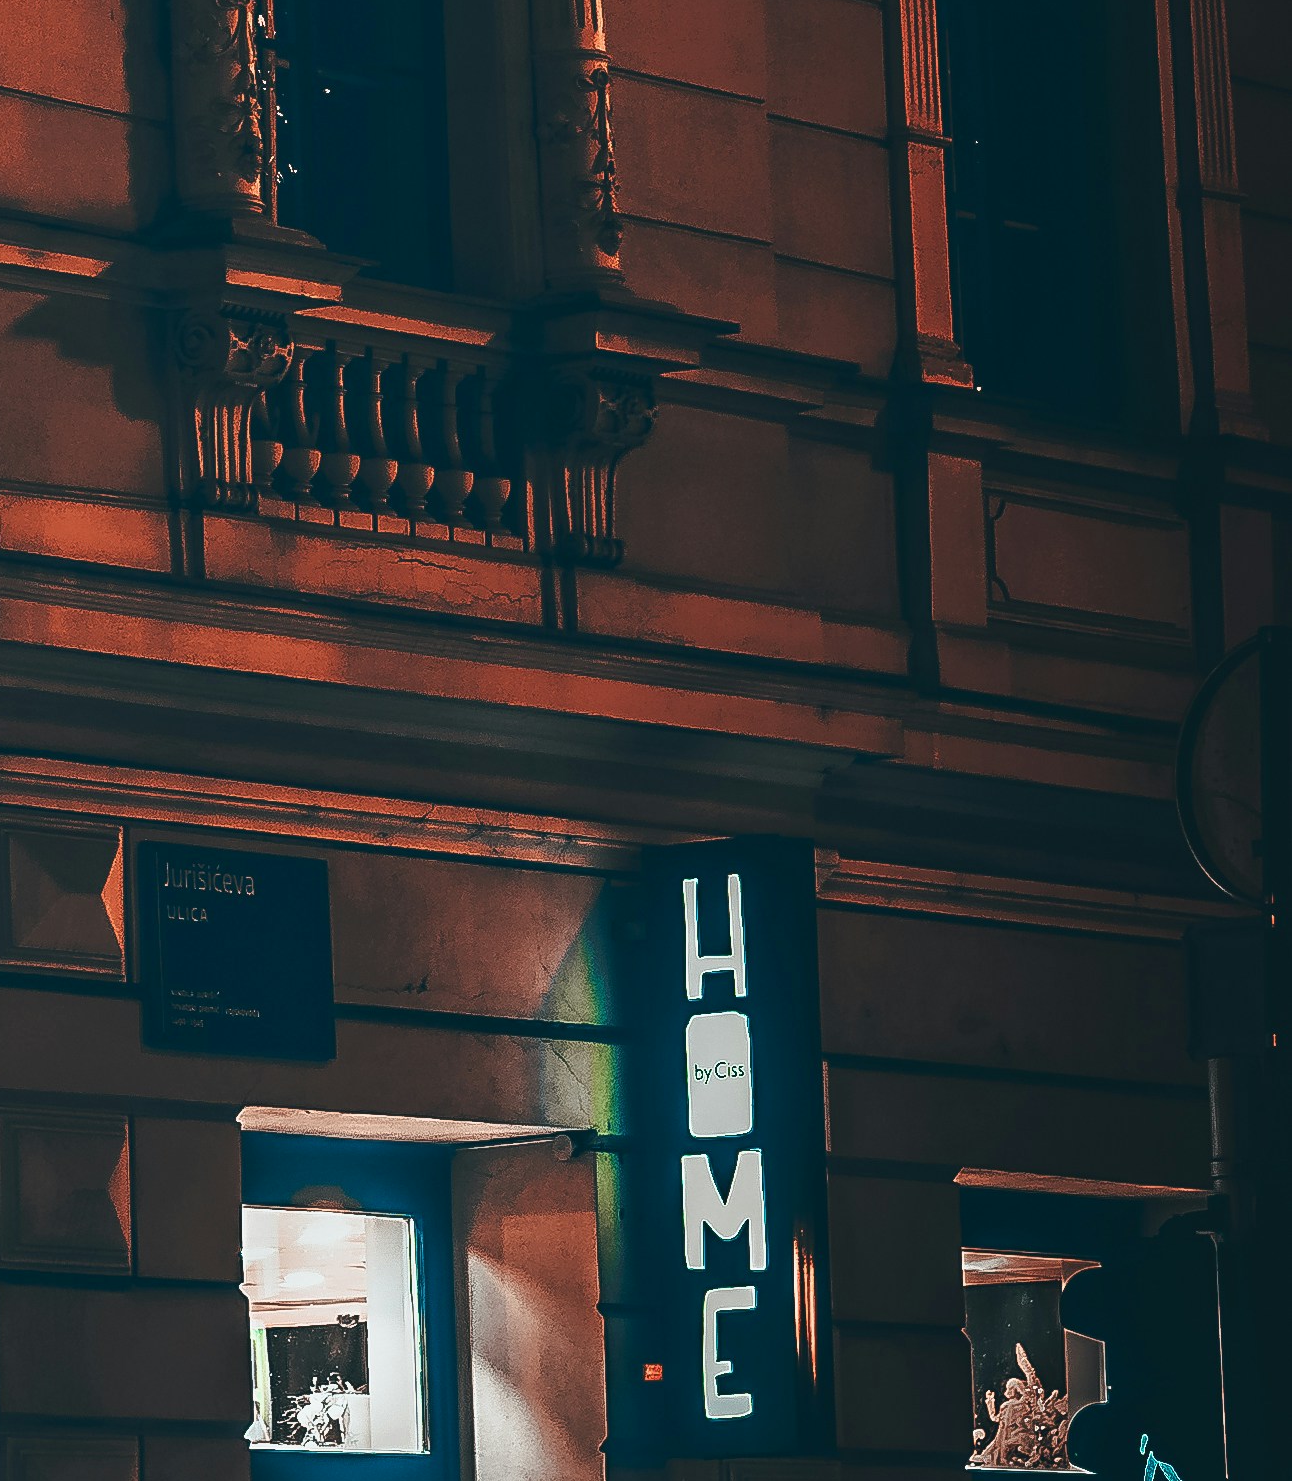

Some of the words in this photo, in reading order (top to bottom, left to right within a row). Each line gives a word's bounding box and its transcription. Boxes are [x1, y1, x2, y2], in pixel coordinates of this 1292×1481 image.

[163, 861, 255, 896] Jurišićeva
[166, 904, 208, 922] ULICA
[695, 1064, 713, 1084] by
[715, 1061, 745, 1078] Ciss
[680, 873, 767, 1420] HOME
